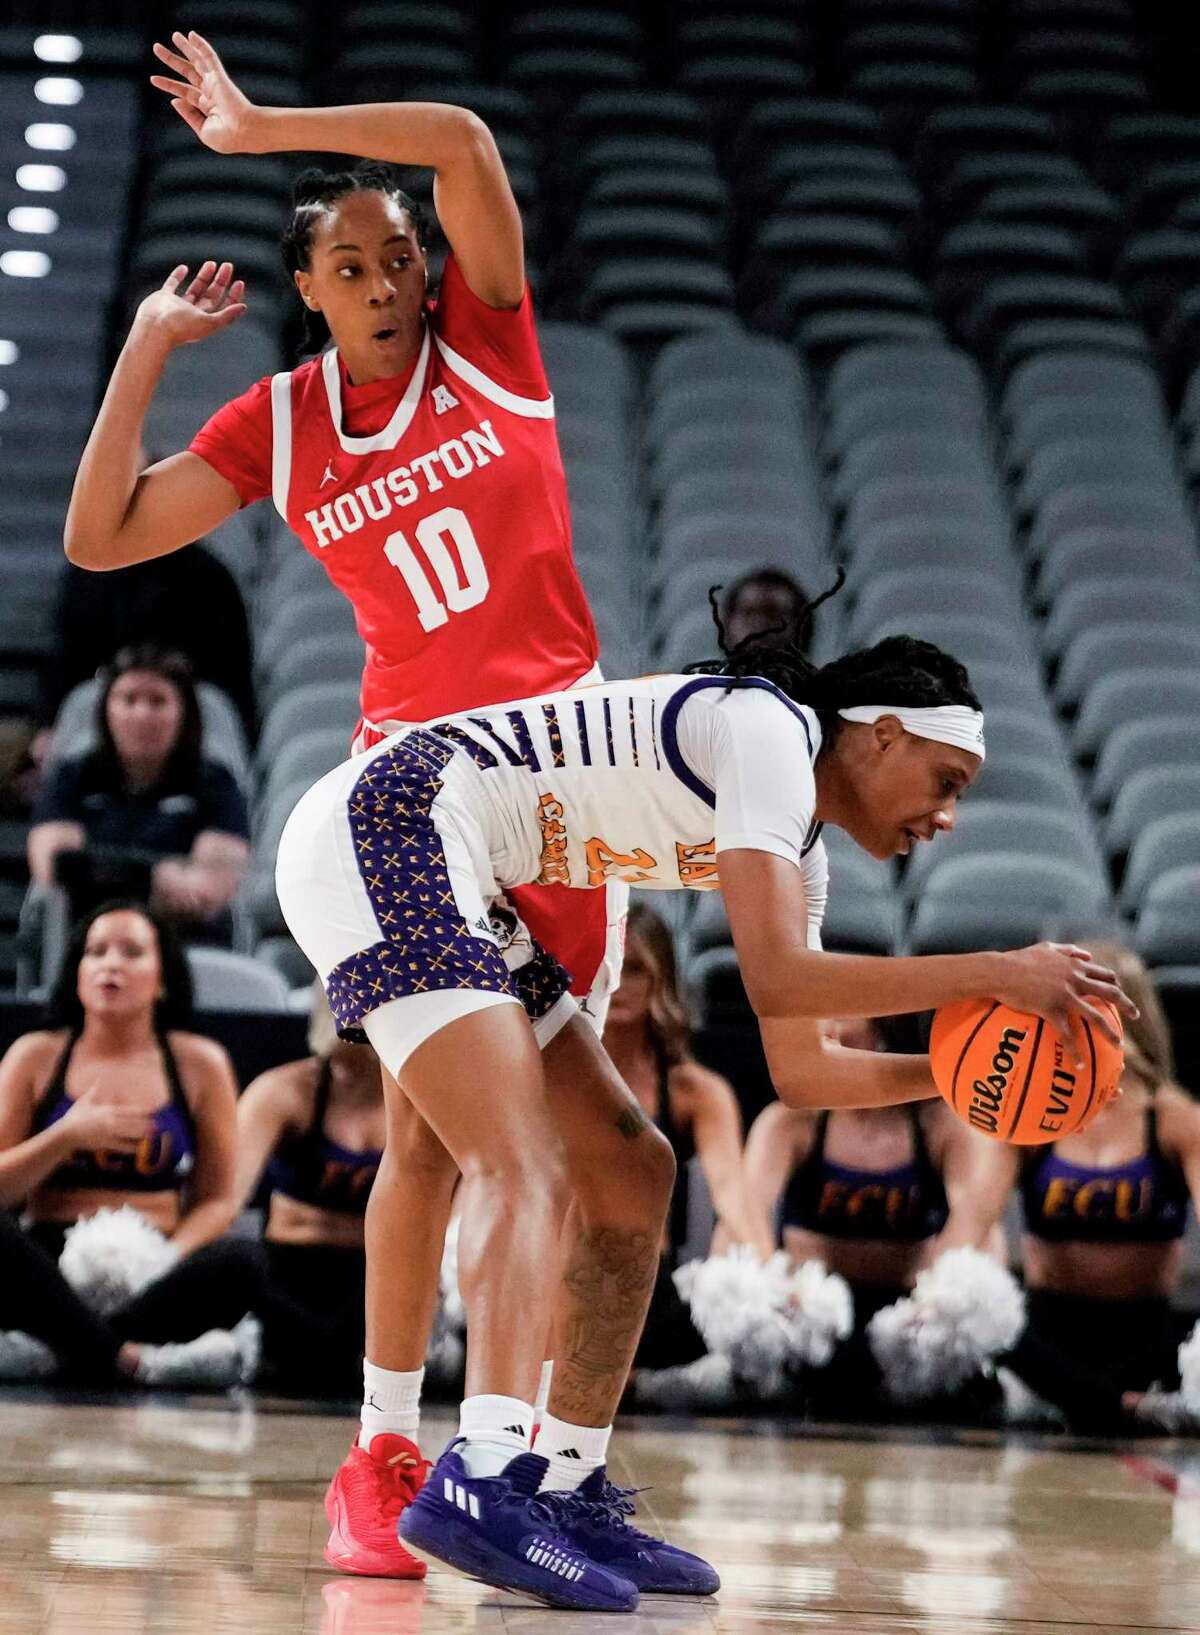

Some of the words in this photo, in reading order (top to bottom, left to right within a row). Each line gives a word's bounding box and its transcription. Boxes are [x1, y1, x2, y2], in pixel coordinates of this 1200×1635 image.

[304, 419, 505, 548] HOUSTON
[383, 506, 490, 633] 10
[967, 1026, 1029, 1134] Wilson
[1039, 1069, 1076, 1132] EVO
[1041, 1176, 1155, 1222] ECU
